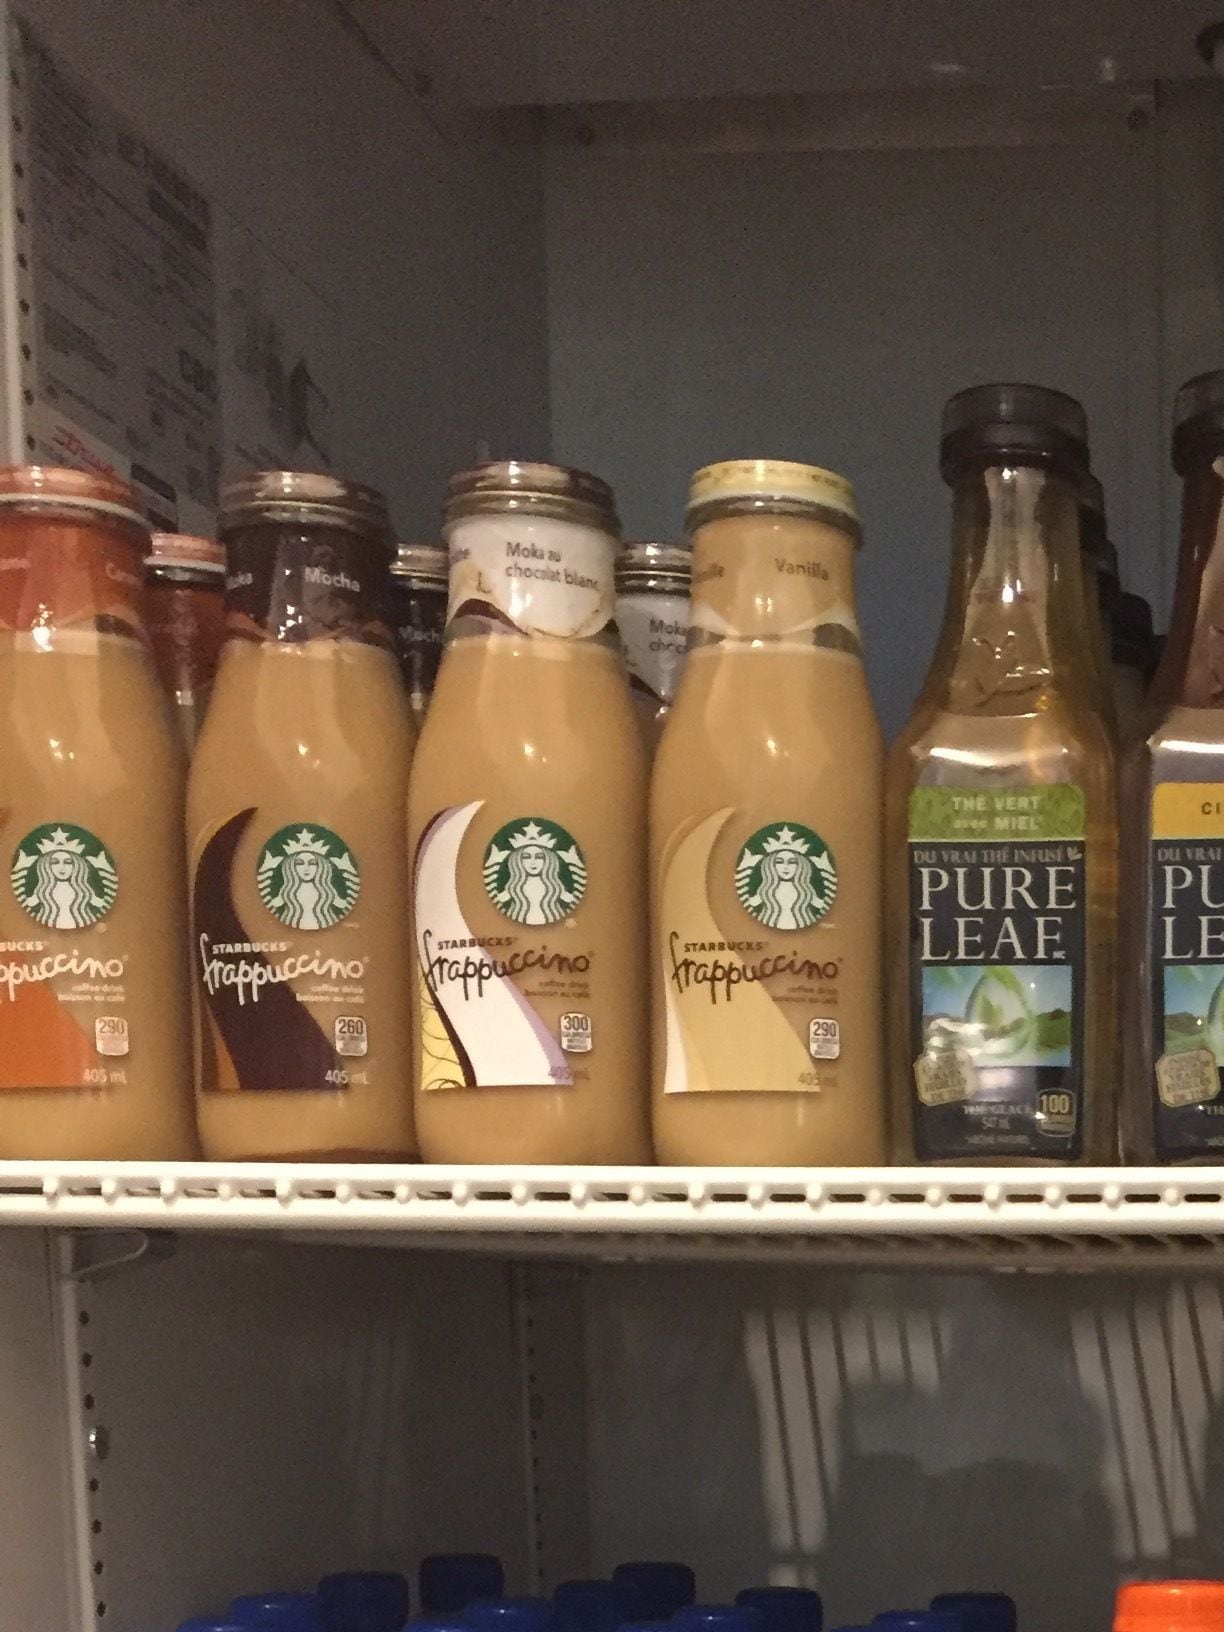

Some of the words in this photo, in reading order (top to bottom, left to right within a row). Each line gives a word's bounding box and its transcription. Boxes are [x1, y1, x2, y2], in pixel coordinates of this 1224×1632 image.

[506, 541, 544, 560] Moka
[505, 564, 561, 584] chocolat
[775, 557, 829, 581] Vanilla
[305, 567, 360, 592] Mocha
[994, 796, 1040, 811] VERT
[994, 816, 1040, 830] MIEL
[914, 850, 937, 863] DU
[1157, 847, 1181, 861] DU
[918, 866, 1076, 910] PURE
[437, 937, 513, 950] STARBUCKS
[683, 941, 763, 953] STARBUCKS
[920, 916, 1063, 960] LEAF
[212, 941, 287, 954] STARBUCKS
[201, 932, 364, 1005] frappuccino
[423, 930, 590, 1001] frappuccino
[669, 931, 840, 1004] frappuccino
[338, 1019, 364, 1035] 260
[564, 1015, 589, 1032] 300
[812, 1020, 837, 1038] 290
[325, 1070, 348, 1084] 405
[1041, 1094, 1069, 1113] 100
